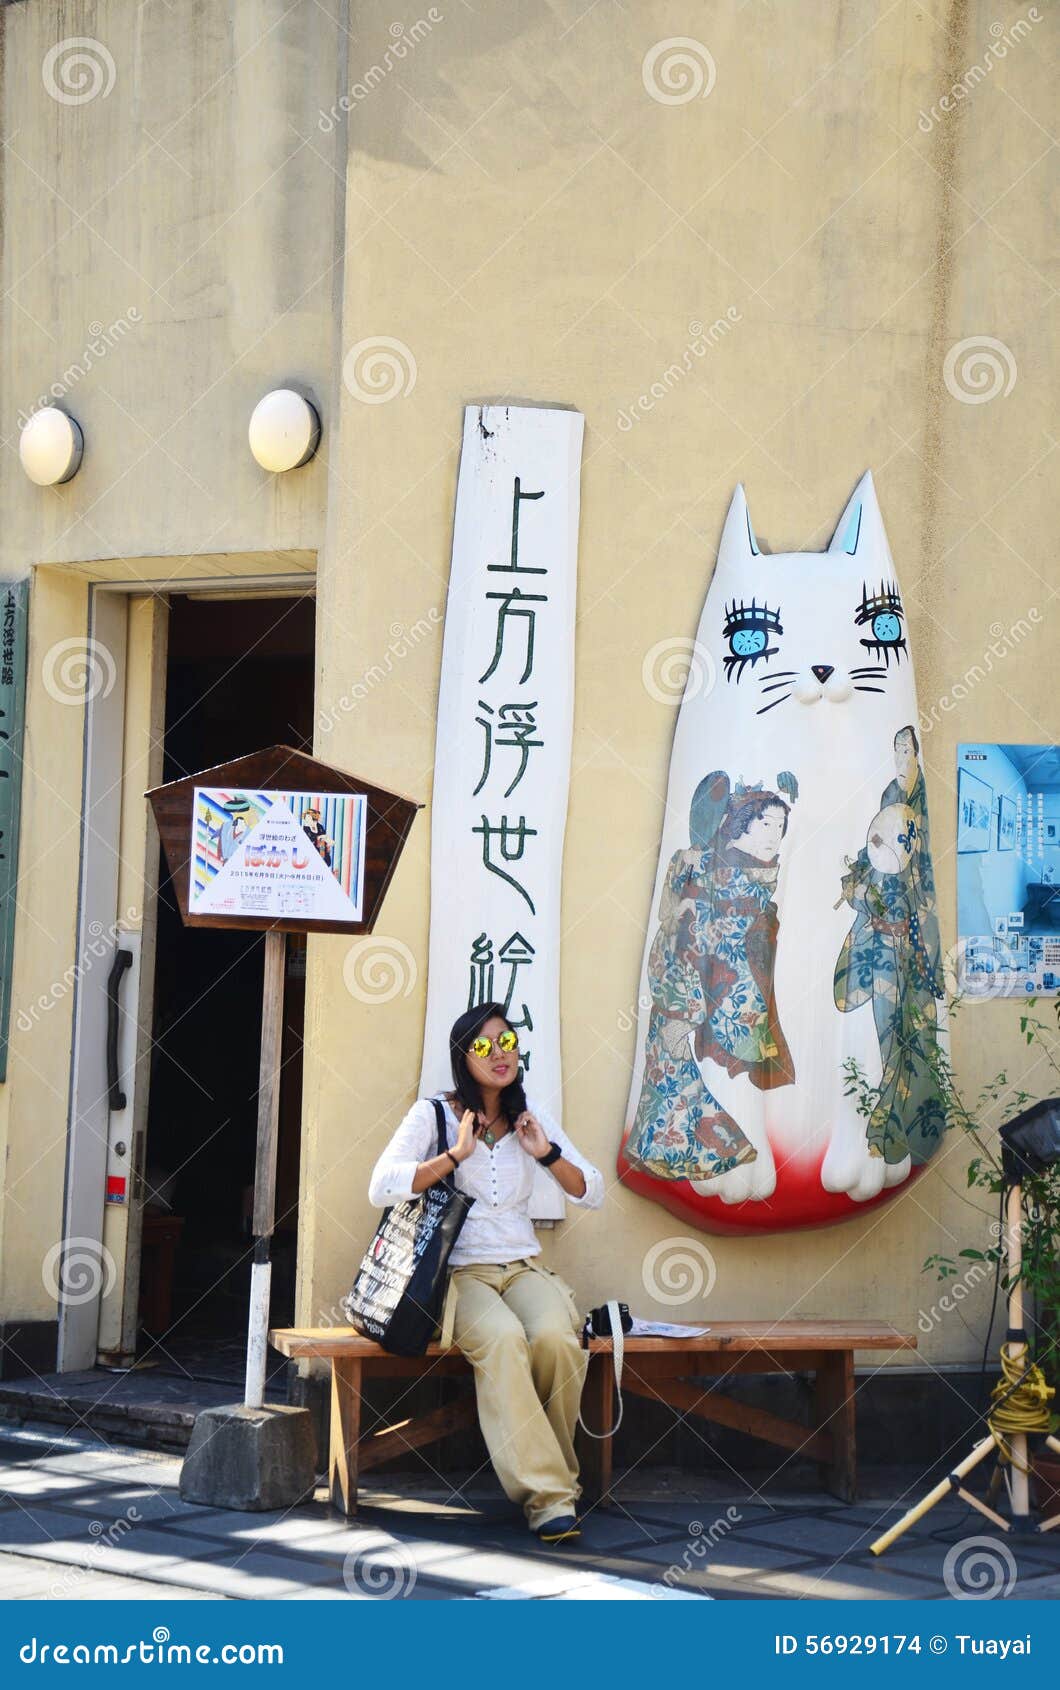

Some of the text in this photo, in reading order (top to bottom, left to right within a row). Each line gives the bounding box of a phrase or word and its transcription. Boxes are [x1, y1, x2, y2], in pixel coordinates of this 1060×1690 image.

[244, 844, 310, 869] ぼかし
[467, 476, 549, 1083] 上方浮世絵
